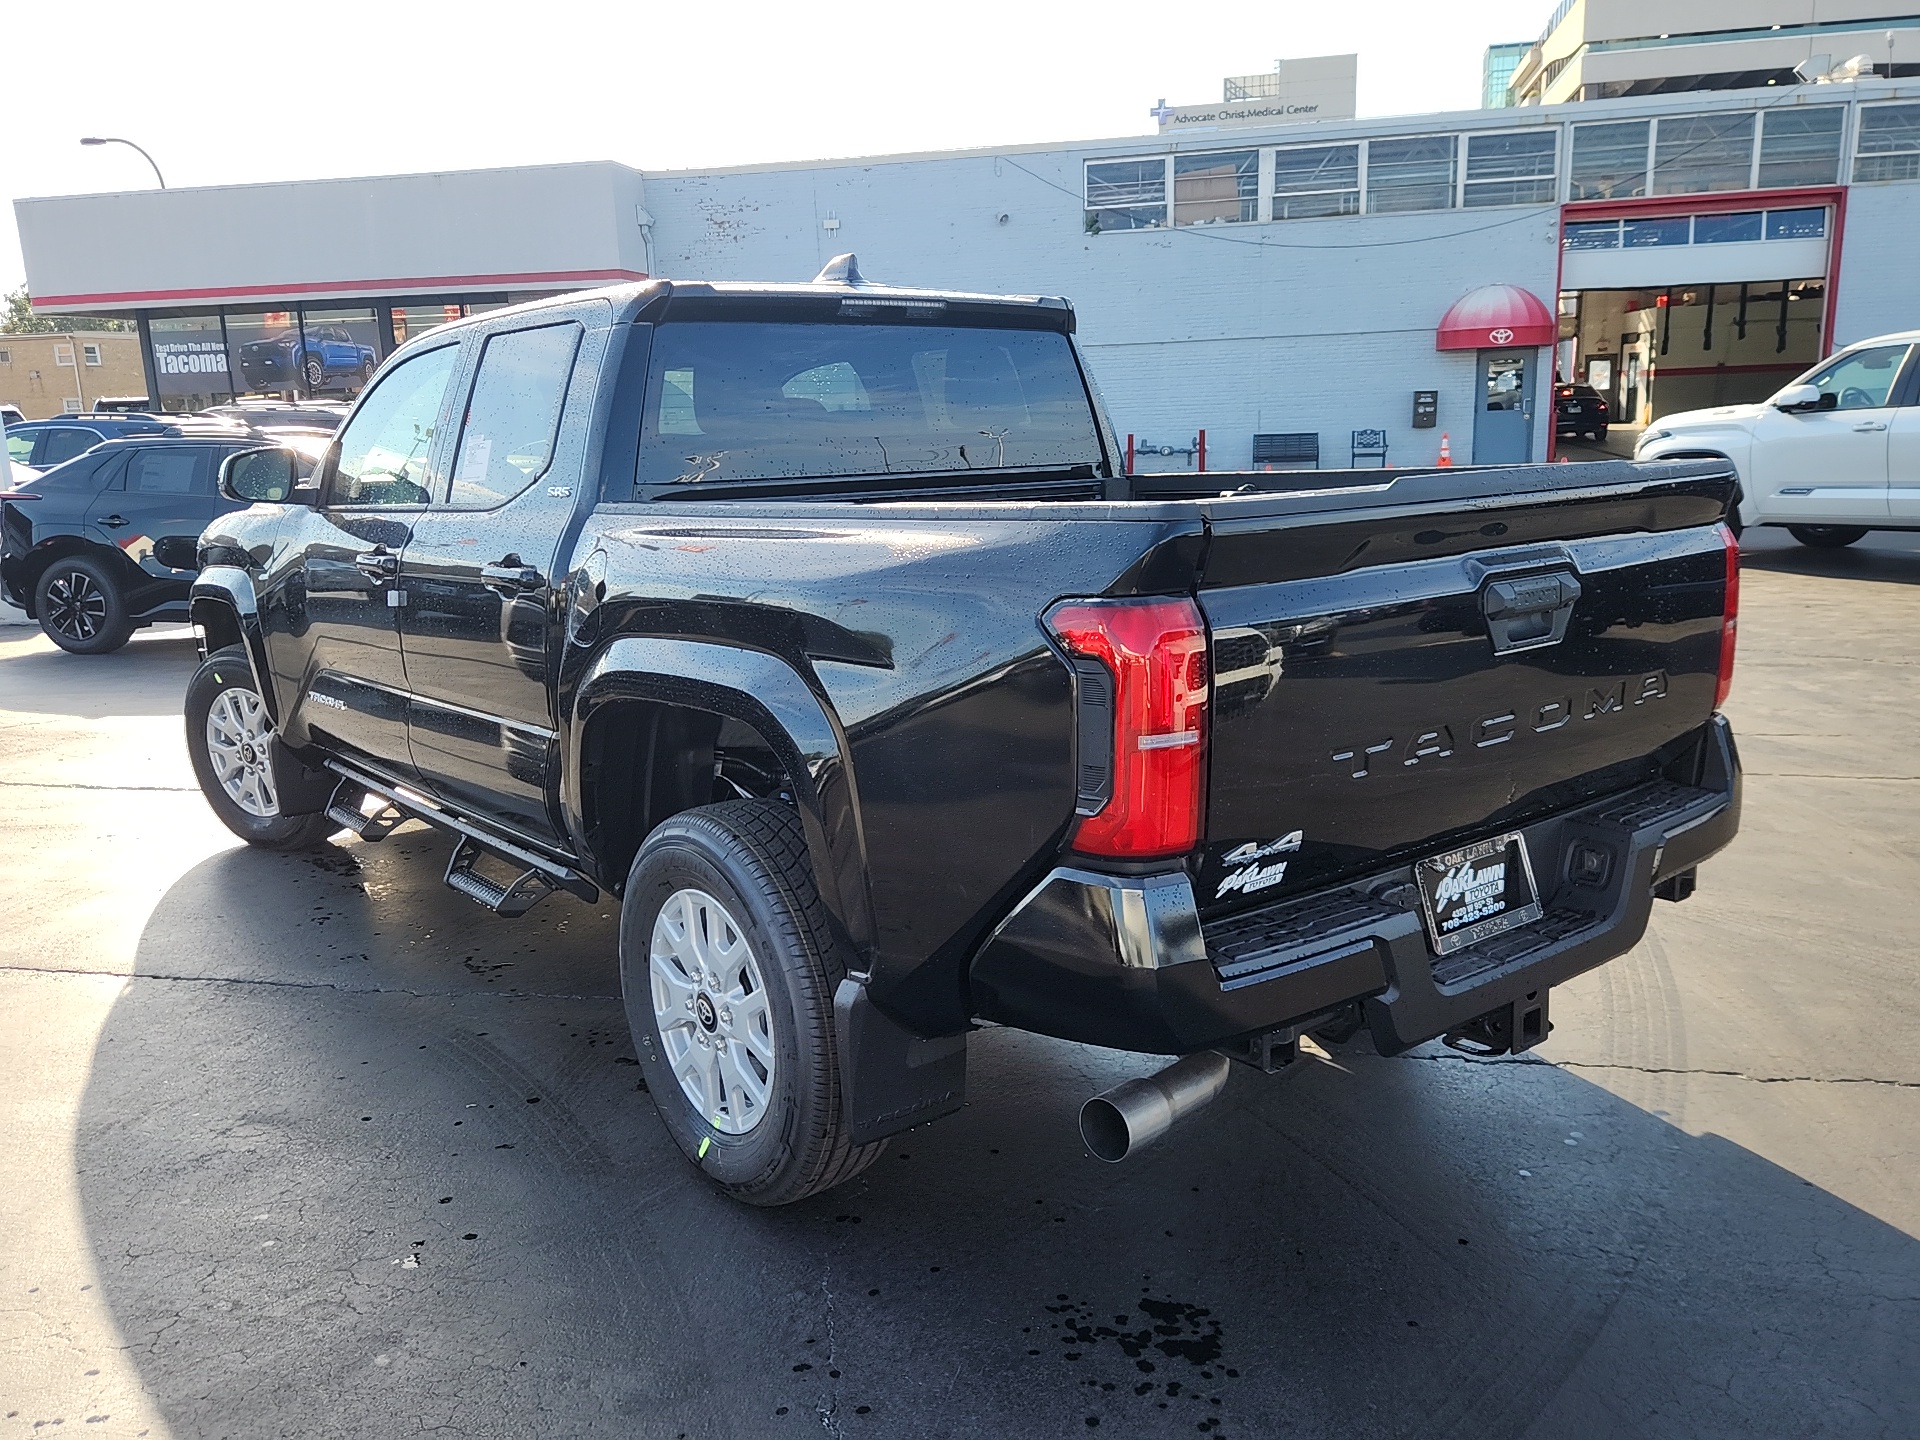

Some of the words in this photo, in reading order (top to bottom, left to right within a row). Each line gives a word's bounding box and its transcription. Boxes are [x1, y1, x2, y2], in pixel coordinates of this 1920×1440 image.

[1173, 113, 1216, 124] Advocate
[1218, 110, 1245, 120] Christ
[1247, 105, 1284, 118] Medical
[1286, 104, 1319, 115] Center
[154, 343, 170, 352] Test
[170, 343, 188, 352] Drive
[188, 342, 201, 352] The
[201, 342, 211, 351] All
[211, 342, 225, 351] New
[155, 352, 230, 374] Tacoma
[547, 486, 571, 498] SR5
[1331, 669, 1670, 779] TACOMA
[1444, 850, 1465, 866] OAK
[1468, 881, 1501, 900] TOYOTA
[1441, 900, 1506, 932] 708-423-5200
[1467, 903, 1474, 912] W
